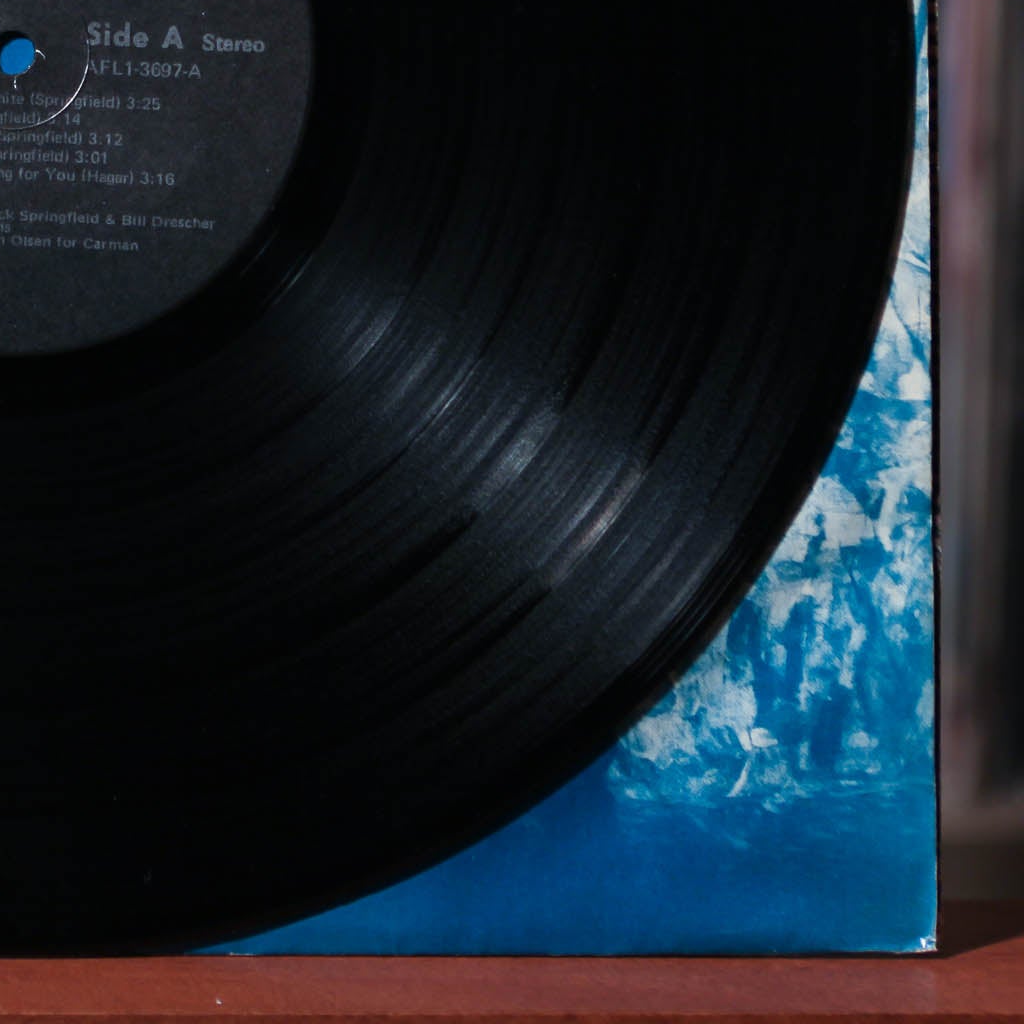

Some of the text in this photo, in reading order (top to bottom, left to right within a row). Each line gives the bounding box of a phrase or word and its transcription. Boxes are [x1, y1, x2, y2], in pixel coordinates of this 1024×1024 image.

[87, 21, 265, 53] Side A Stereo
[127, 96, 161, 111] 3:25
[76, 150, 108, 165] 3:01
[18, 166, 40, 181] for
[45, 167, 76, 182] You
[139, 172, 175, 186] 3:16
[19, 210, 99, 226] Springfield
[105, 214, 116, 225] &
[122, 214, 147, 227] Bill
[151, 216, 216, 231] Drescher
[11, 236, 52, 249] Olsen
[57, 236, 78, 250] for
[83, 238, 140, 252] Carman
